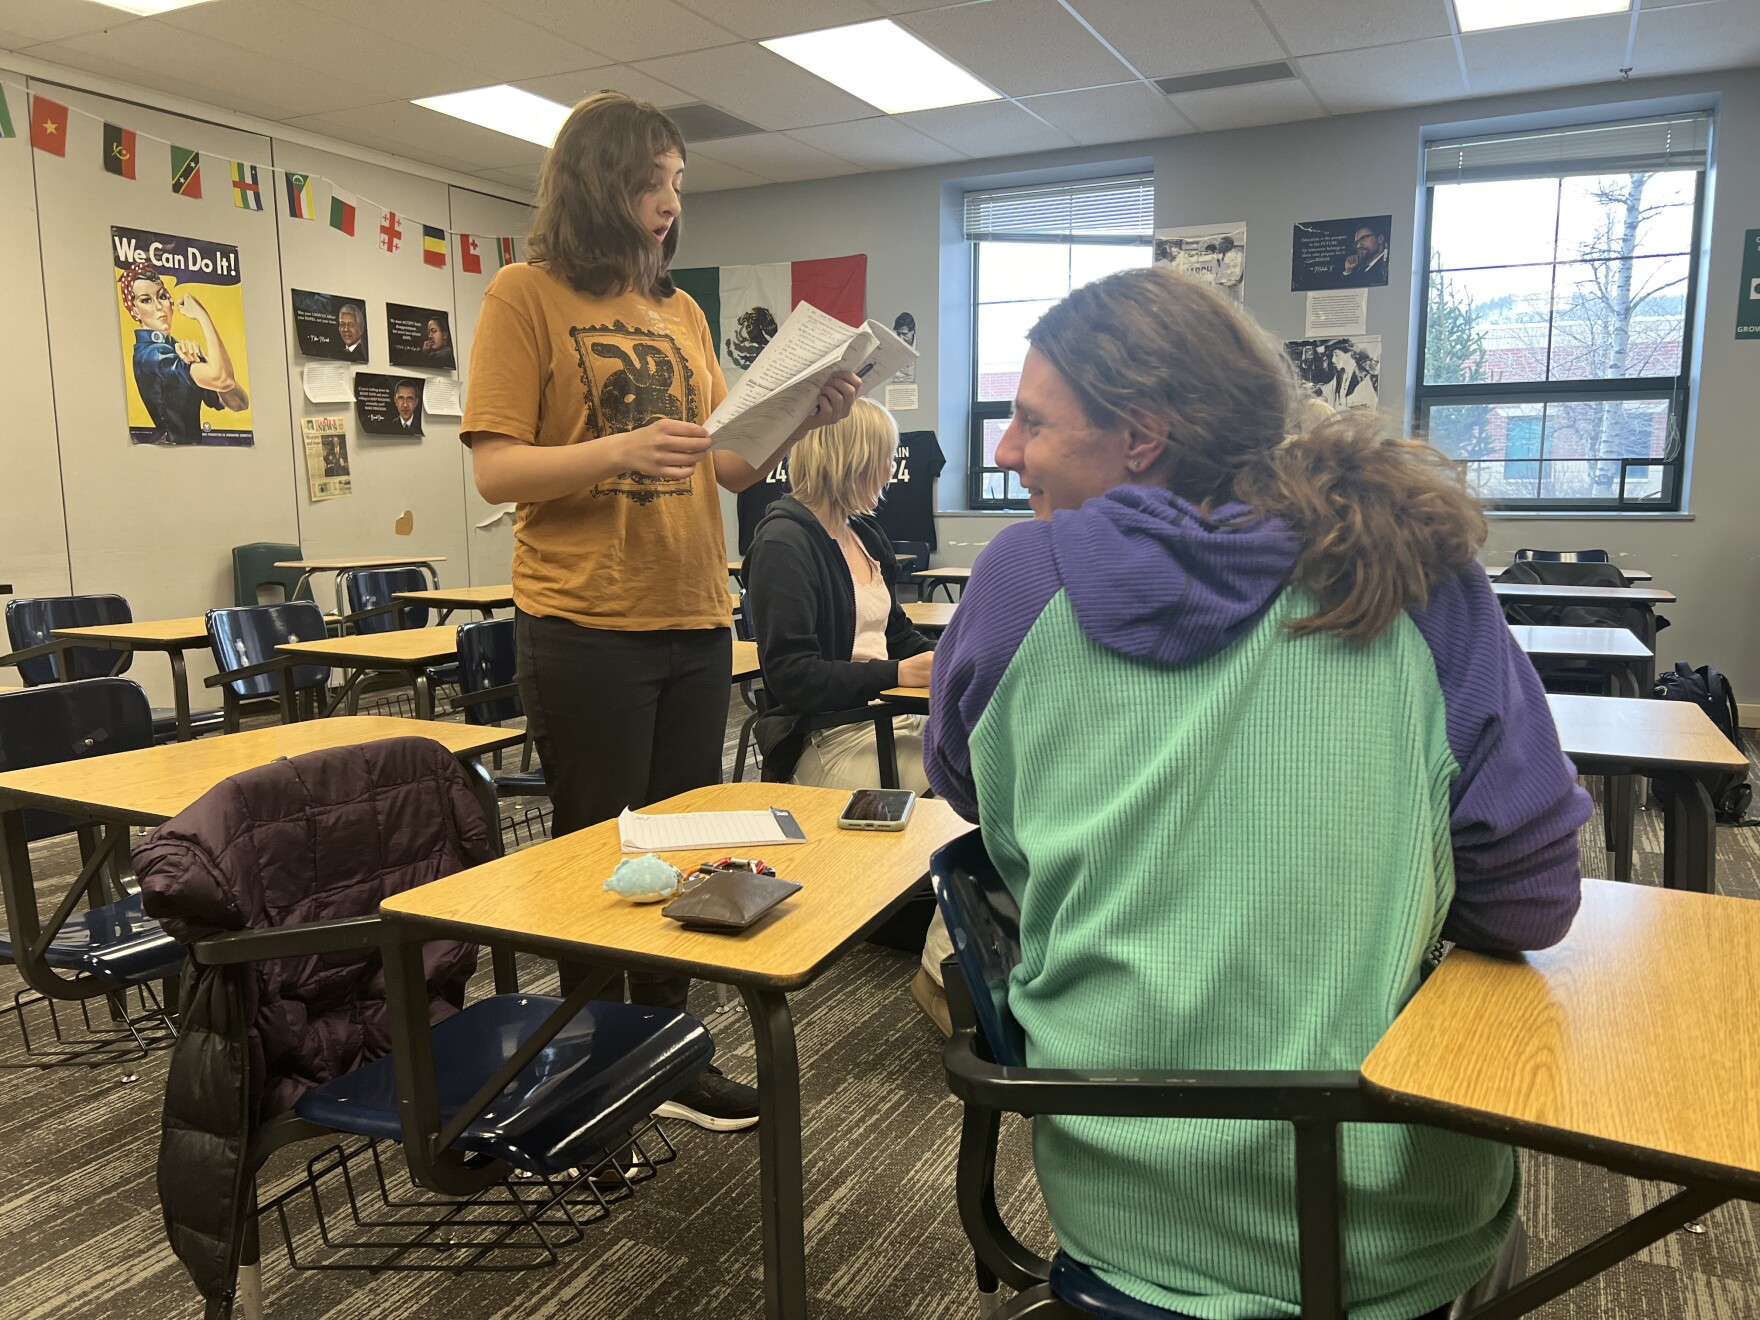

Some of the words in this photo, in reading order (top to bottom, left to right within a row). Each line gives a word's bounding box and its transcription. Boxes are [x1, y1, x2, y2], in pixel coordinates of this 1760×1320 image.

[114, 236, 147, 263] We
[149, 242, 185, 270] Can
[187, 246, 213, 273] Do
[216, 251, 236, 276] It!
[890, 459, 910, 483] 24
